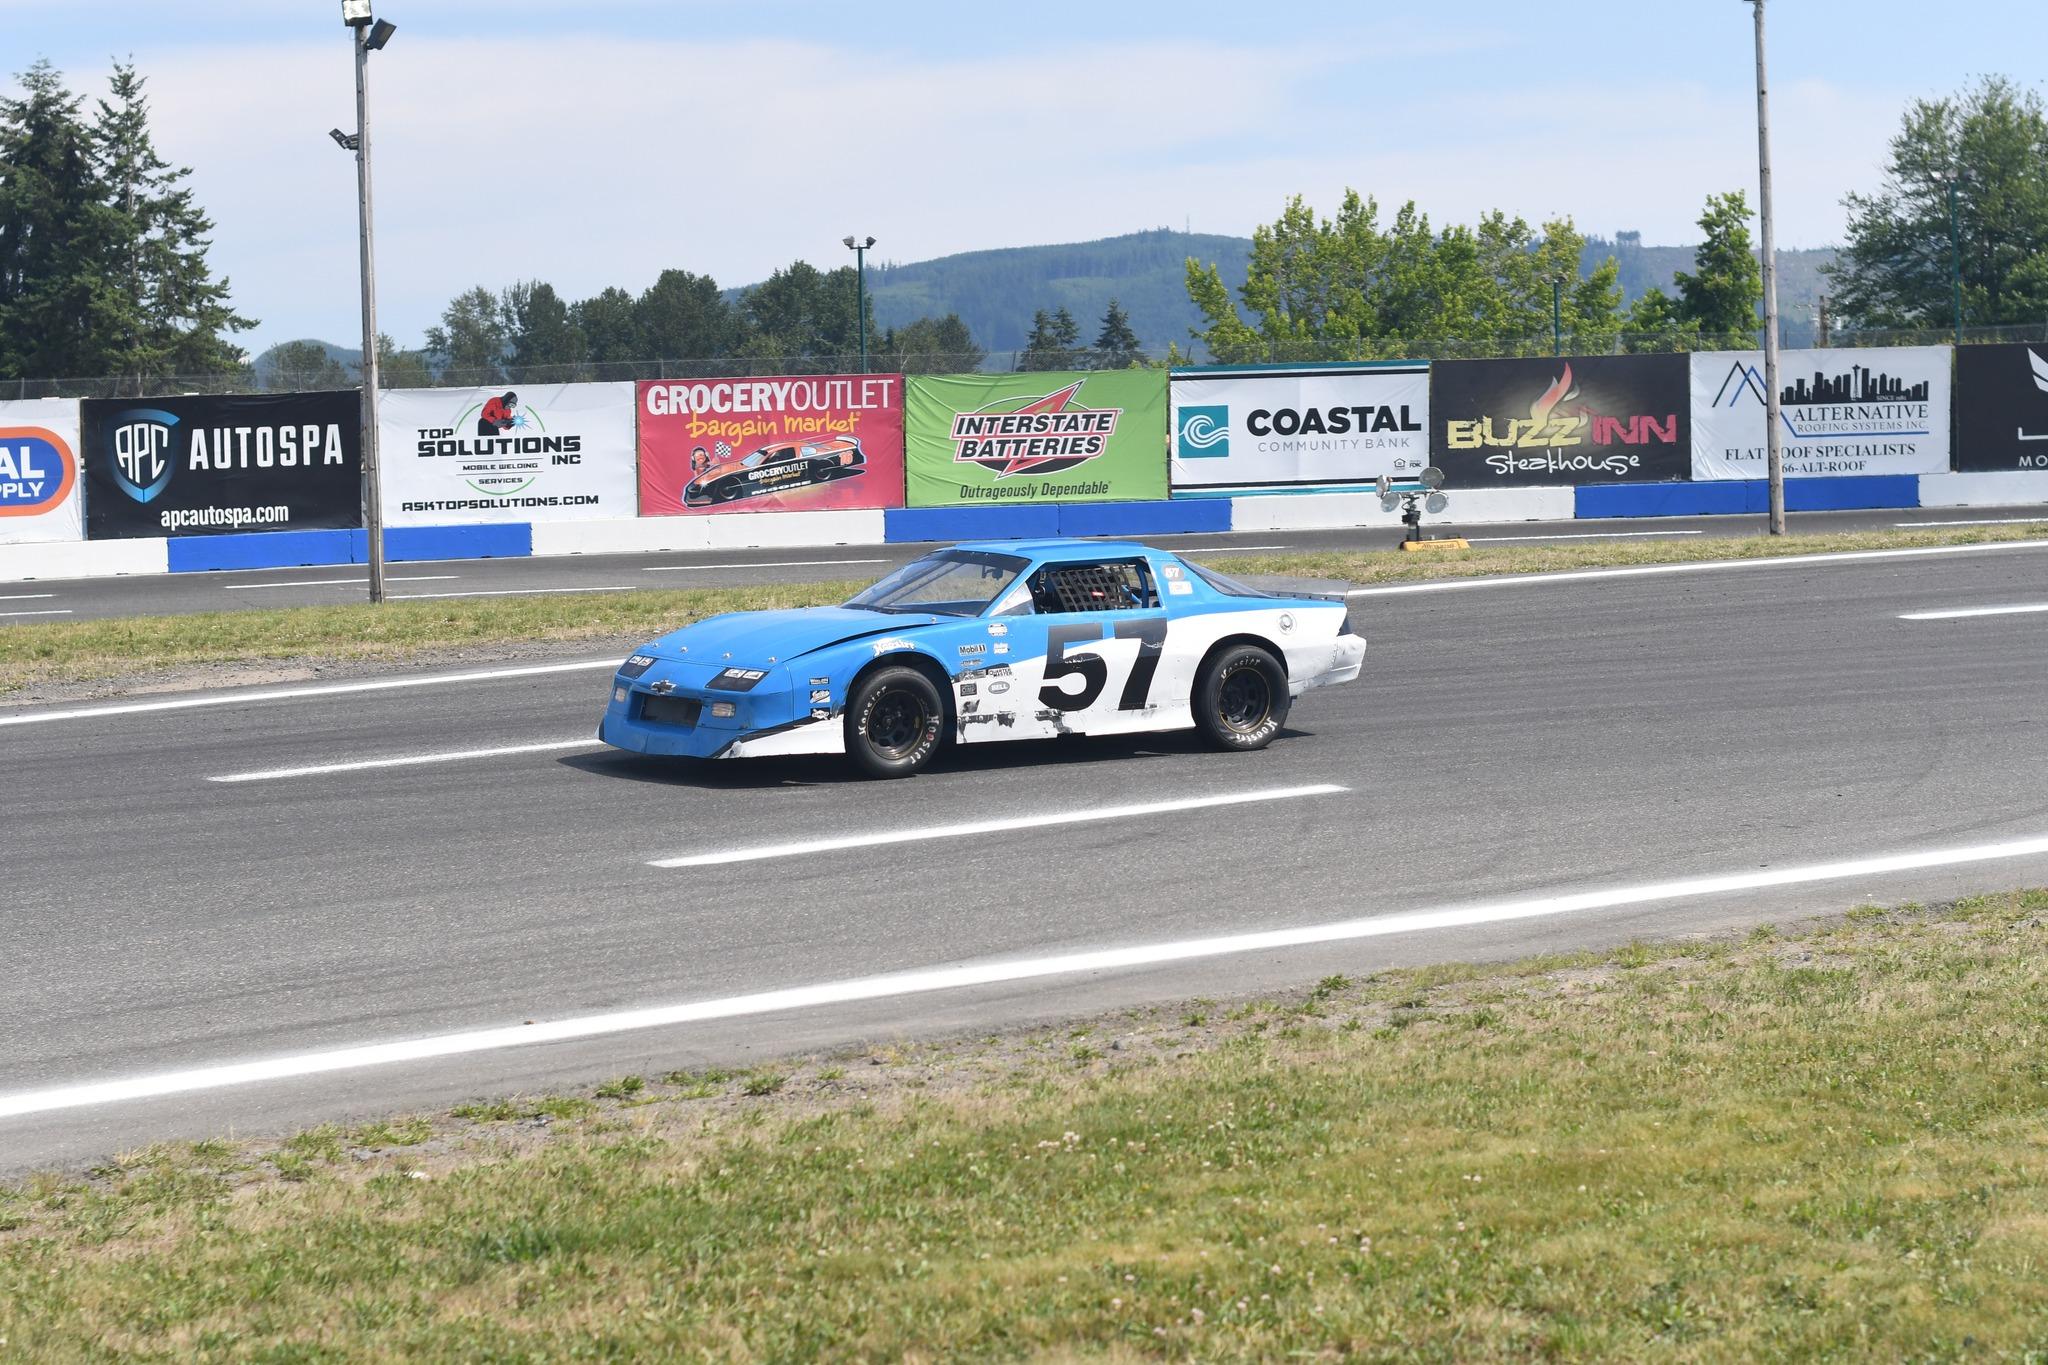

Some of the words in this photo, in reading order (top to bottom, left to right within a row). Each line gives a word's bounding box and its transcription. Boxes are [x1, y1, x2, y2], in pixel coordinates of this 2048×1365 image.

[1246, 404, 1422, 437] COASTAL
[1793, 404, 1929, 422] ALTERNATIVE
[685, 409, 777, 448] bargain
[783, 411, 859, 434] market
[956, 413, 1114, 436] INTERSTATE
[1447, 415, 1582, 449] BUZZ
[1592, 414, 1677, 446] INN
[1797, 422, 1849, 433] ROOFING
[1852, 421, 1903, 432] SYSTEMS
[1906, 420, 1929, 430] INC.
[417, 428, 455, 440] TOP
[115, 423, 169, 483] APC
[189, 423, 344, 470] AUTOSPA
[417, 435, 582, 458] SOLUTIONS
[960, 436, 1102, 459] BATTERIES
[1257, 439, 1360, 453] COMMUNITY
[1365, 437, 1411, 449] BANK
[1725, 447, 1765, 460] FLAT
[1780, 446, 1812, 459] OOF
[1815, 443, 1917, 458] SPECIALISTS
[462, 463, 497, 471] MOBILE
[498, 462, 539, 470] WELDING
[552, 454, 582, 466] INC
[1781, 460, 1867, 473] 66-ALT-ROOF
[478, 476, 524, 485] SERVICES
[0, 481, 45, 499] PLY
[960, 482, 1037, 500] Outrageously
[1041, 481, 1109, 498] Dependable
[402, 495, 599, 512] ASKTOPSOLUTIONS.COM
[161, 504, 289, 531] apcautospa.com
[1038, 617, 1168, 712] 57
